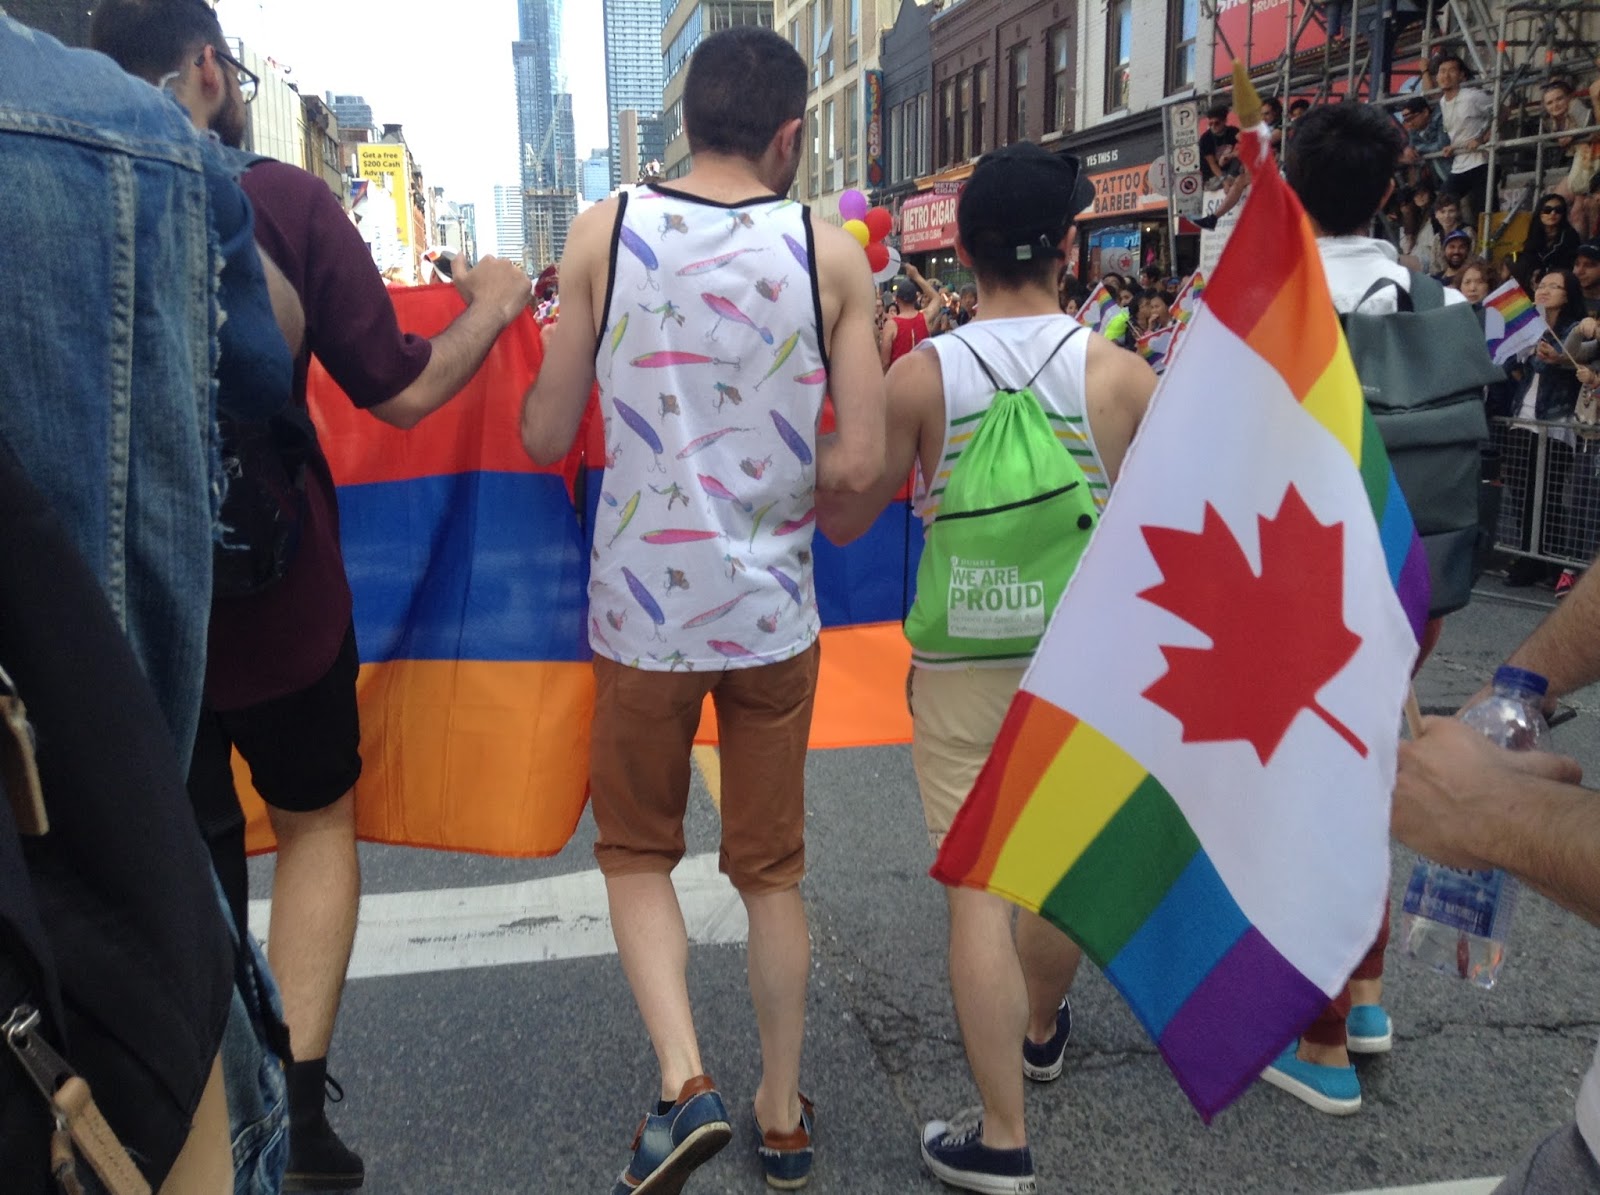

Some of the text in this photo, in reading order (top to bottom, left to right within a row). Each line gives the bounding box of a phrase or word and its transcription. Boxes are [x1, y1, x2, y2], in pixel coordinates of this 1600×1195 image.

[363, 160, 381, 168] $200
[1086, 149, 1119, 167] YES THIS IS
[1095, 172, 1140, 195] TATTOO
[1094, 192, 1138, 213] BARBER
[903, 198, 956, 232] METRO CIGAR
[952, 568, 1018, 586] WE ARE
[950, 584, 1043, 611] PROUD
